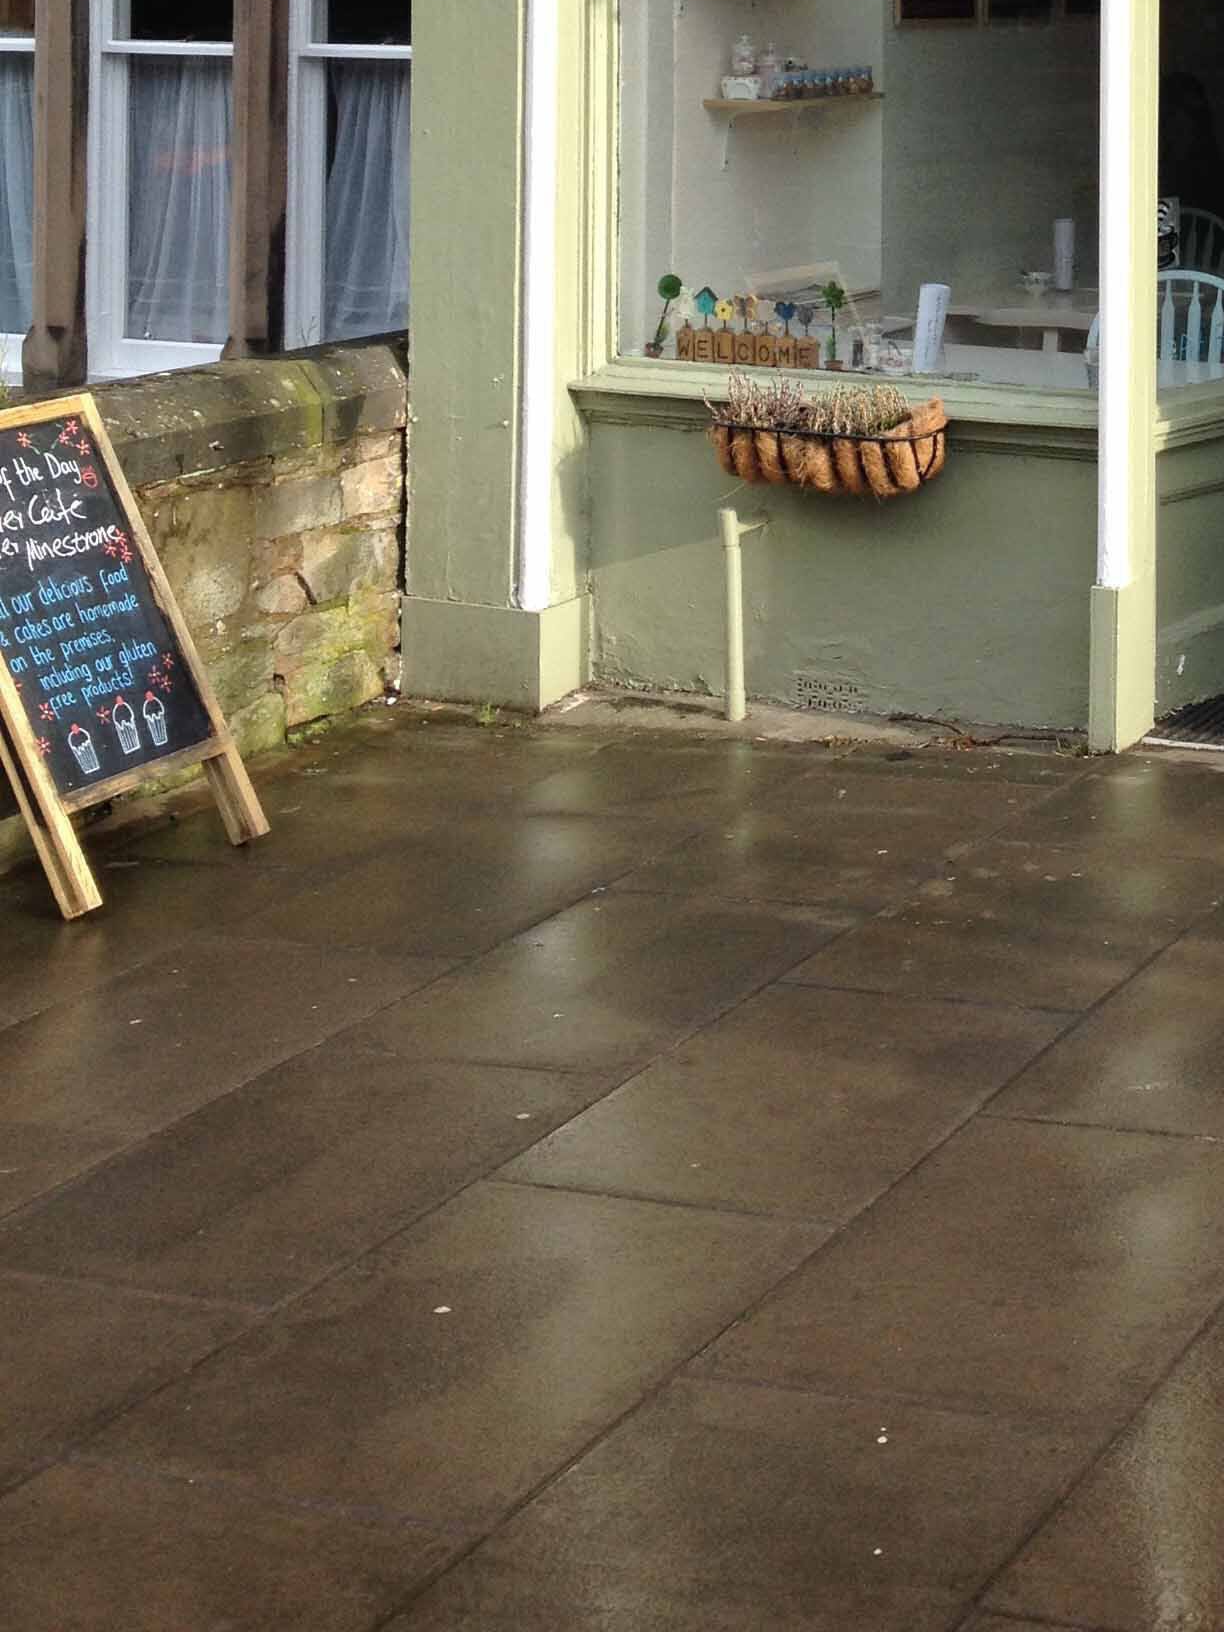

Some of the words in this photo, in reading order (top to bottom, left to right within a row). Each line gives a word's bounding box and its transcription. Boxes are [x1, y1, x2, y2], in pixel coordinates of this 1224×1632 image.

[677, 337, 813, 368] WELCOME
[0, 466, 15, 501] f
[12, 457, 44, 486] the
[43, 452, 82, 484] Day
[26, 524, 122, 572] Minestrone
[11, 591, 35, 615] our
[38, 575, 94, 605] delicious
[14, 617, 52, 644] cakes
[52, 611, 75, 632] are
[74, 593, 139, 624] homemade
[10, 655, 28, 673] on
[28, 645, 56, 666] the
[37, 662, 93, 691] including
[95, 654, 114, 672] our
[118, 639, 158, 668] gluten
[50, 691, 78, 720] free
[80, 667, 134, 708] products!
